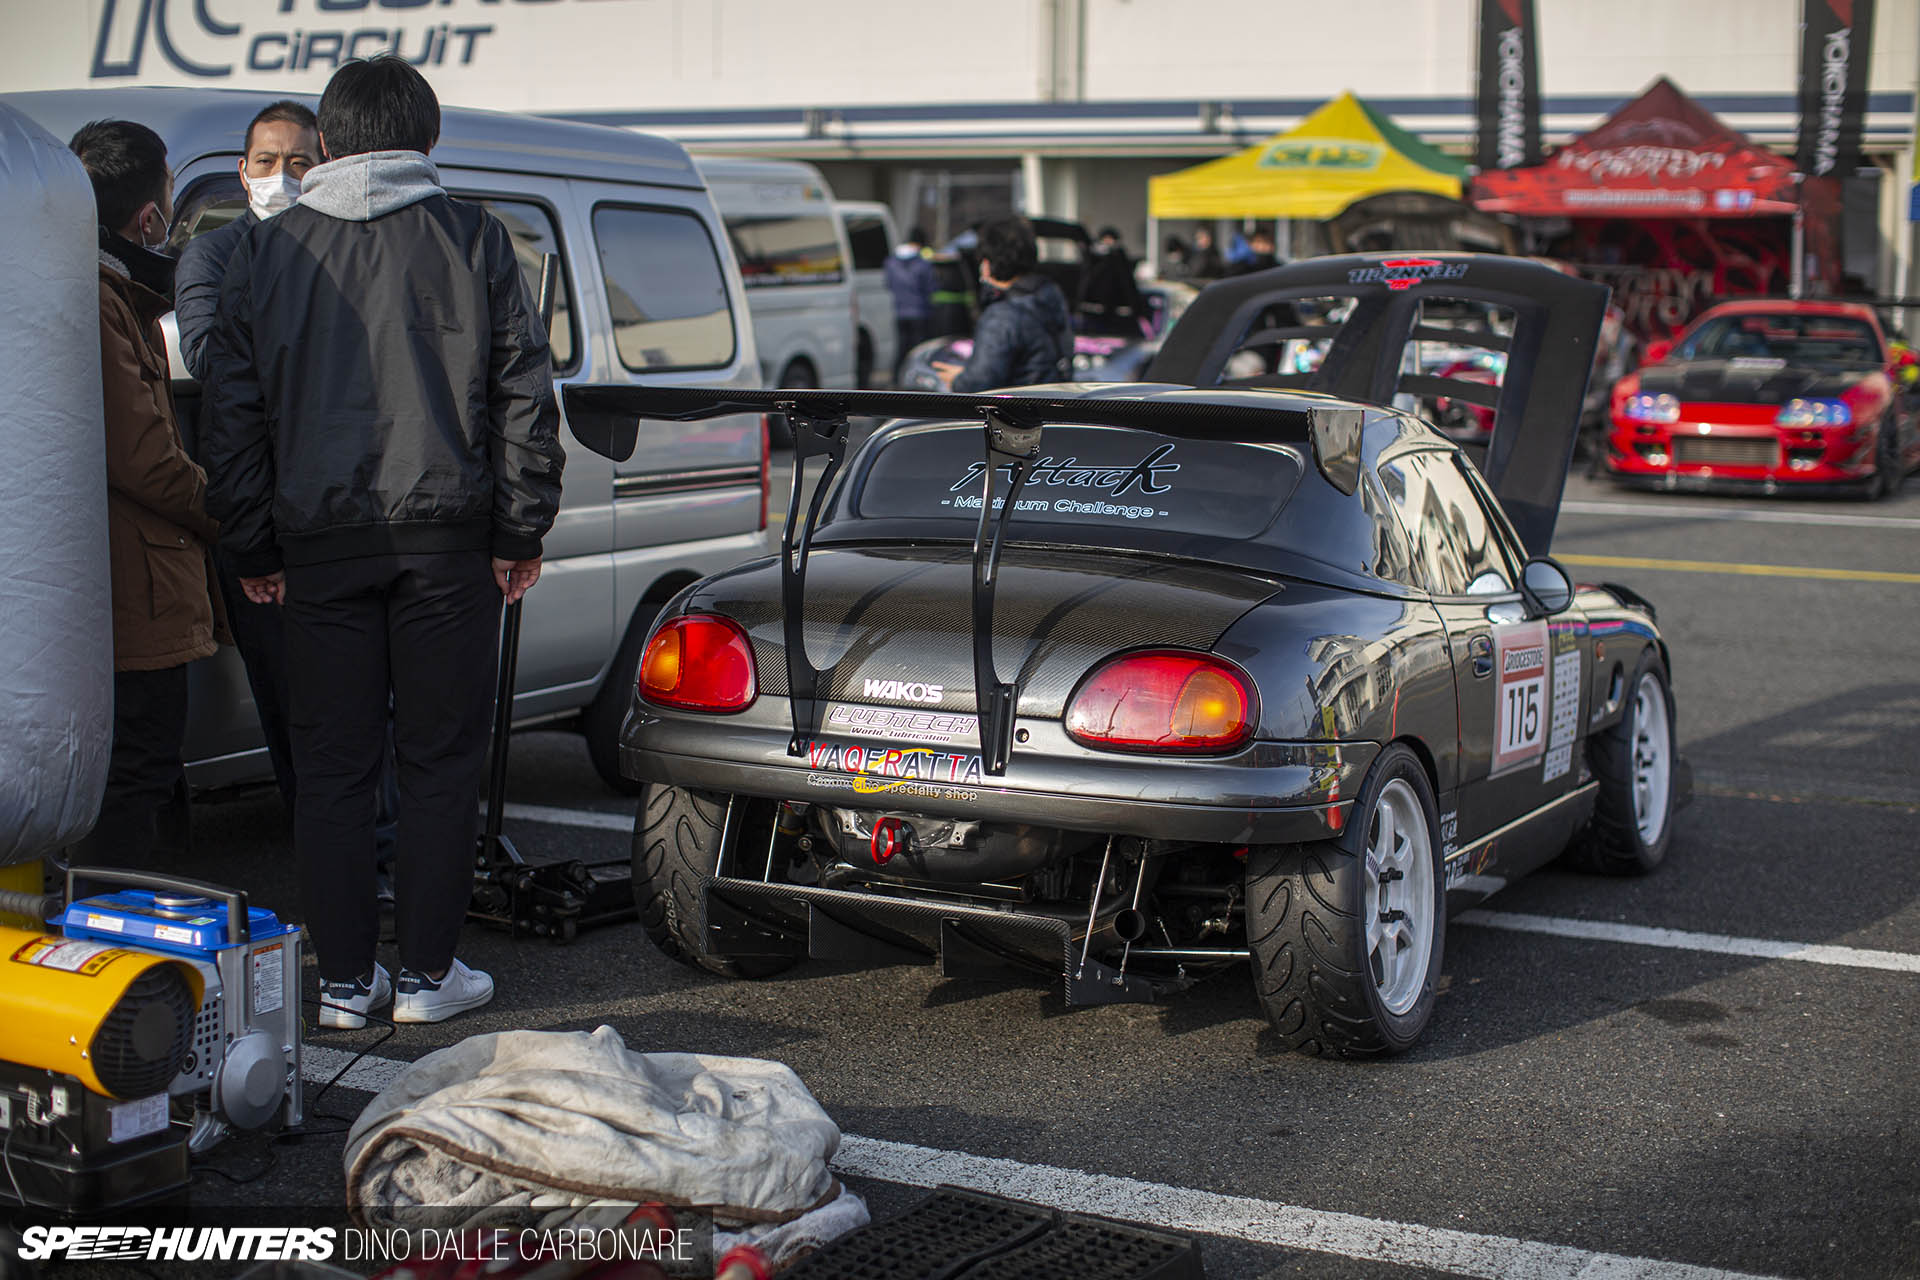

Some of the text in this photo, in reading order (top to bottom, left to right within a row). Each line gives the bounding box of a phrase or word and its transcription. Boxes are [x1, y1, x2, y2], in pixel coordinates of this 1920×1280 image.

[1497, 27, 1525, 170] YOKOHAMA
[1814, 28, 1852, 178] YOKOHAMA
[1054, 499, 1154, 519] Challenge
[1504, 648, 1544, 673] BRIDGESTONE
[828, 705, 977, 734] LUBTECH
[1508, 683, 1539, 747] 115
[850, 727, 884, 737] World
[884, 782, 942, 799] specialty
[944, 788, 978, 802] shop
